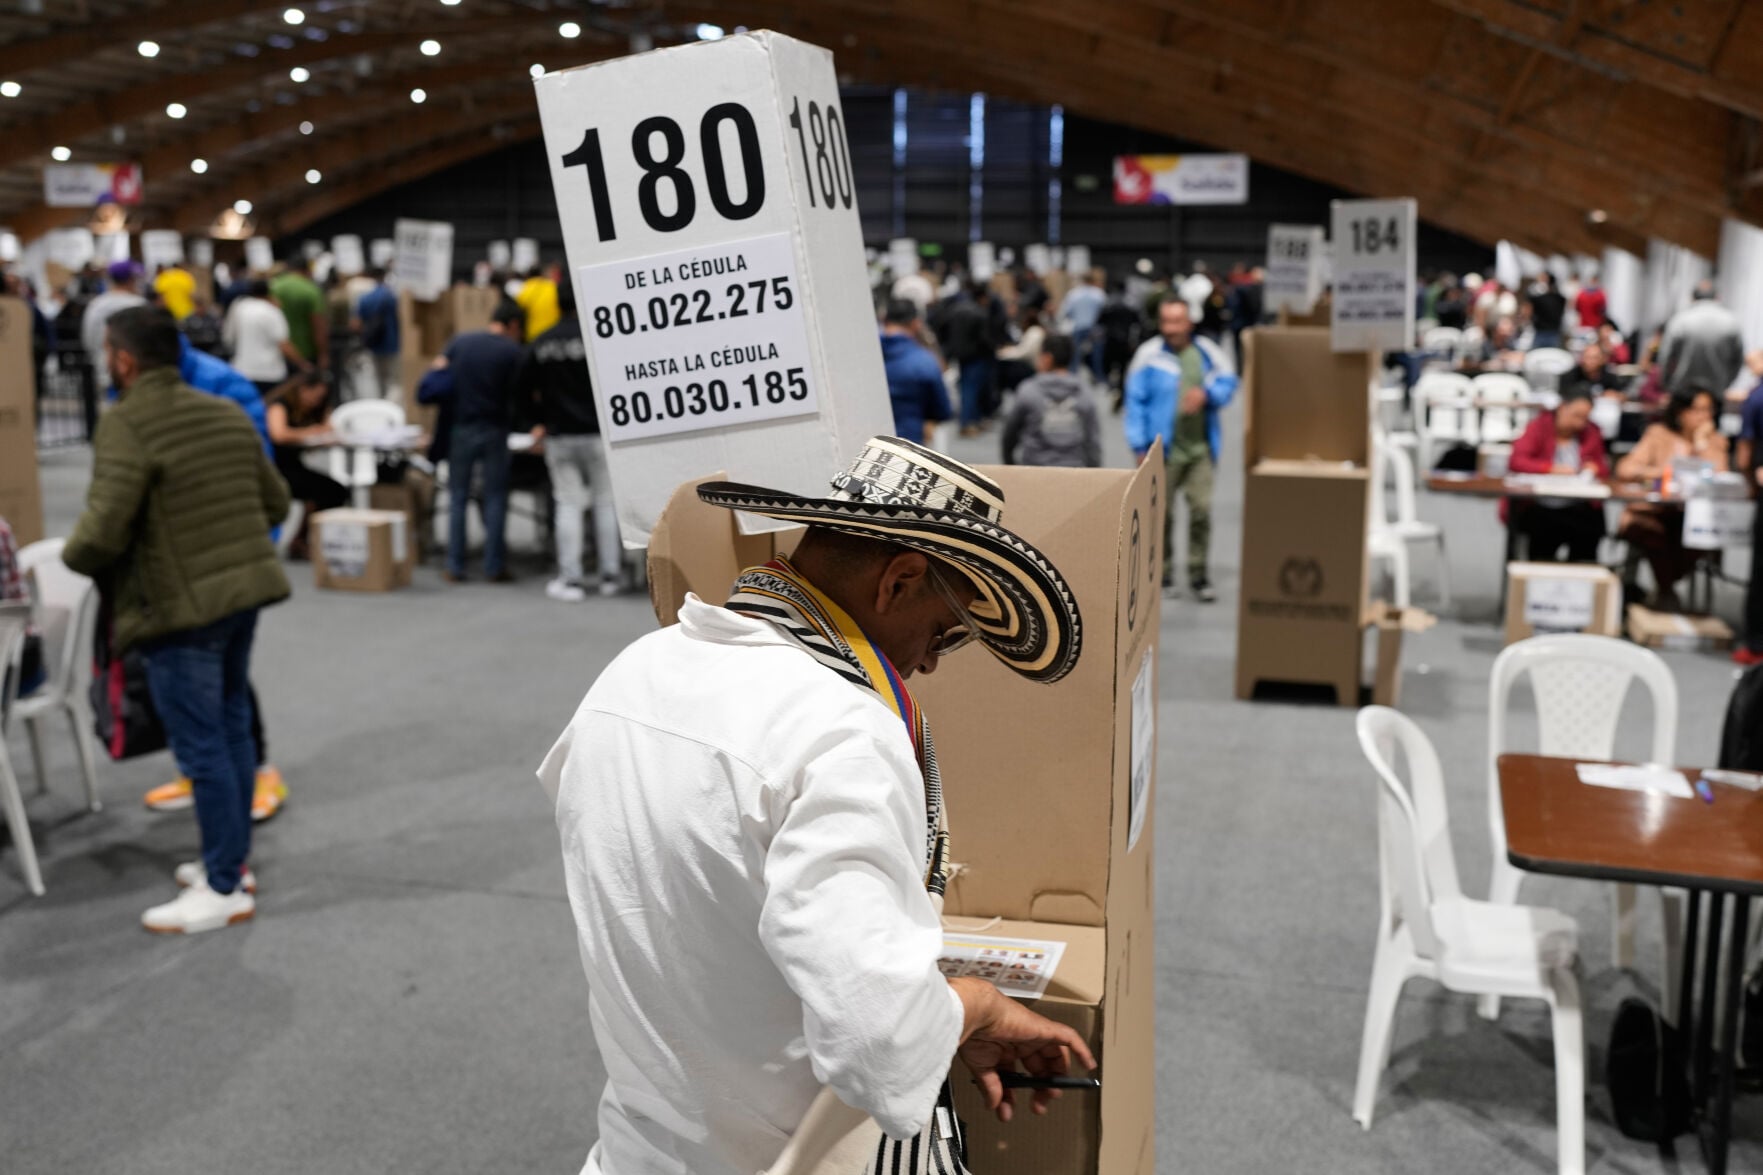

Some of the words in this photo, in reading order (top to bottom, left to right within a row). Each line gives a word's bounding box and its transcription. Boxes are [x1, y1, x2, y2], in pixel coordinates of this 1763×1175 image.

[561, 102, 766, 243] 180
[789, 95, 853, 210] 180
[1351, 217, 1399, 254] 184
[624, 272, 647, 289] DE
[652, 267, 674, 284] LA
[678, 254, 748, 281] CÉDULA
[593, 276, 793, 339] 80.022.275
[624, 357, 679, 381] HASTA
[684, 354, 705, 372] LA
[710, 342, 780, 368] CÉDULA
[609, 367, 808, 427] 80.030.185
